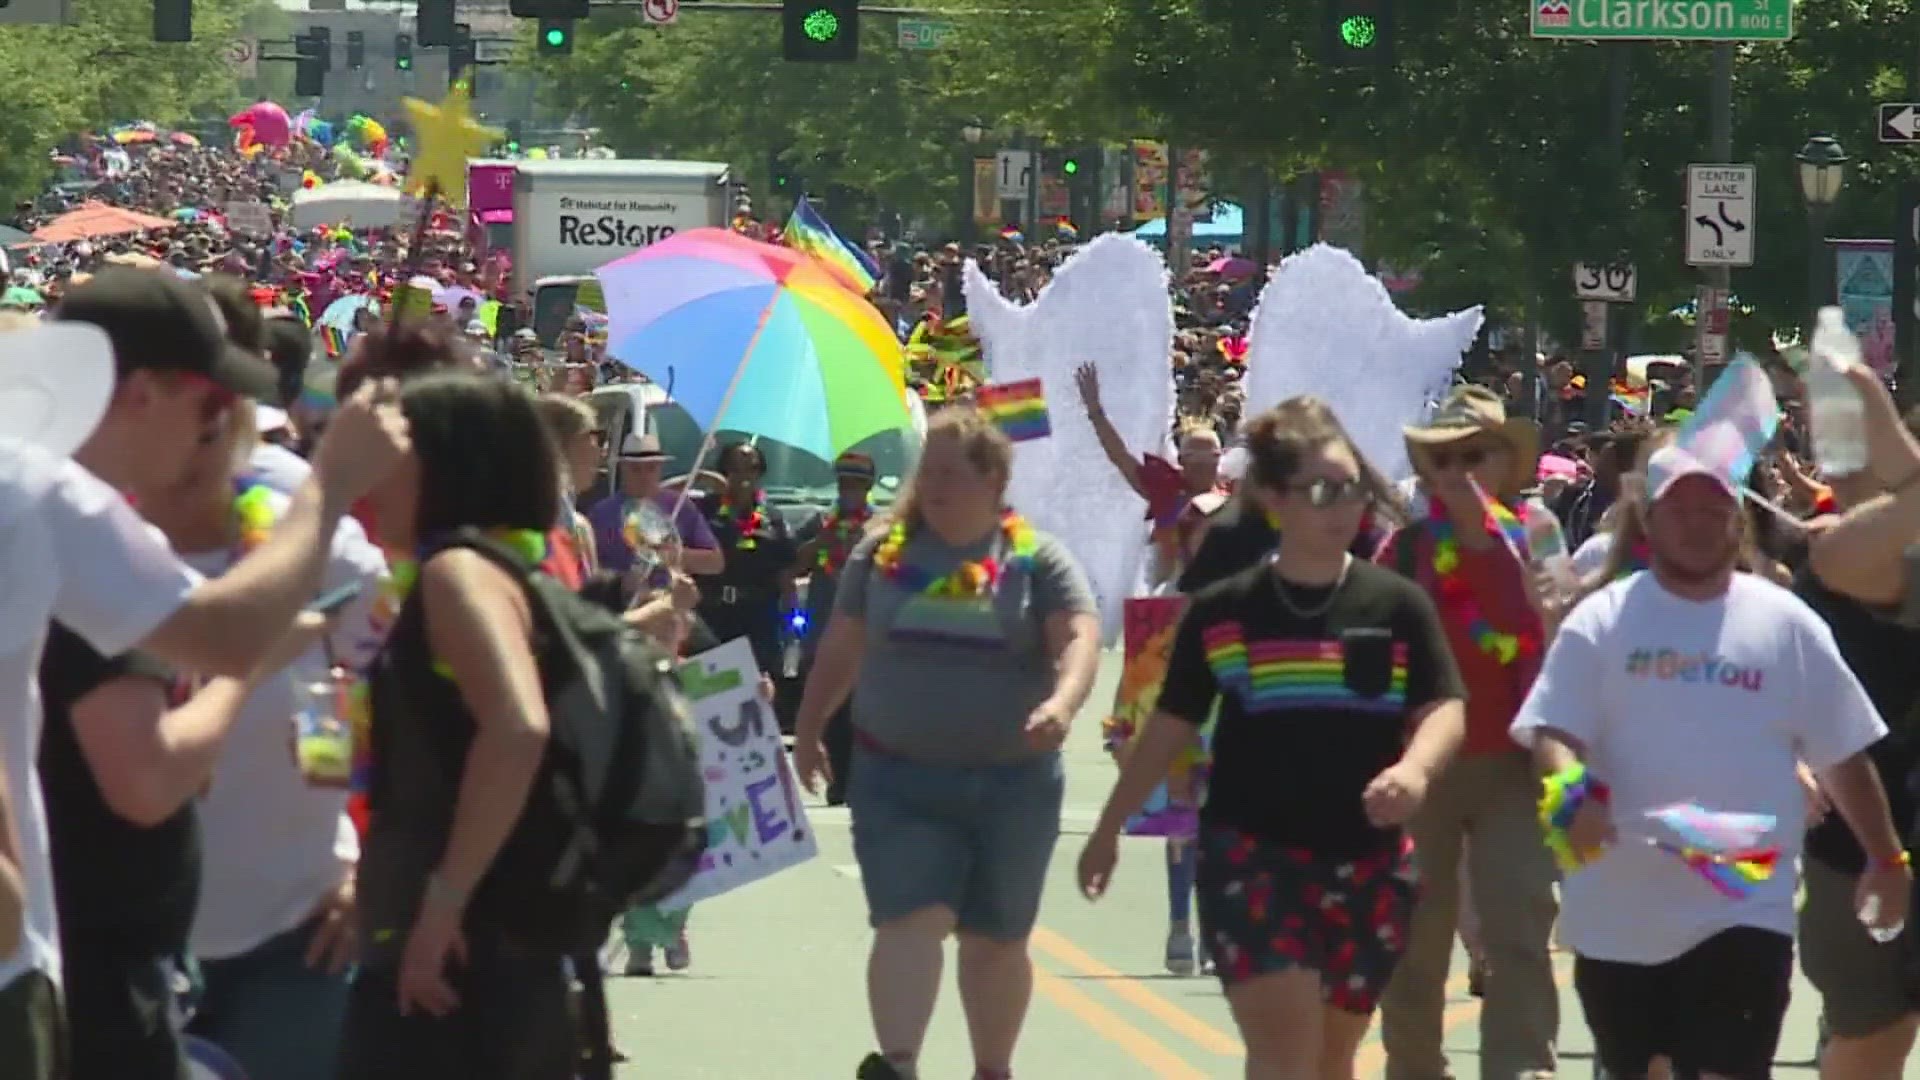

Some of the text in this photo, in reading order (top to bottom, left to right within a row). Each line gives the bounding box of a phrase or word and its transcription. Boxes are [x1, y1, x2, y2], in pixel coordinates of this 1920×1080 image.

[1577, 0, 1734, 30] Clarkson
[1740, 14, 1785, 30] 800 E
[1698, 171, 1745, 181] CENTER
[1704, 183, 1738, 194] LANE
[576, 200, 677, 214] Habitat for Humanity
[559, 215, 675, 247] ReStore
[1703, 249, 1736, 259] ONLY
[1580, 262, 1628, 291] 30
[1625, 648, 1763, 692] #BeYou
